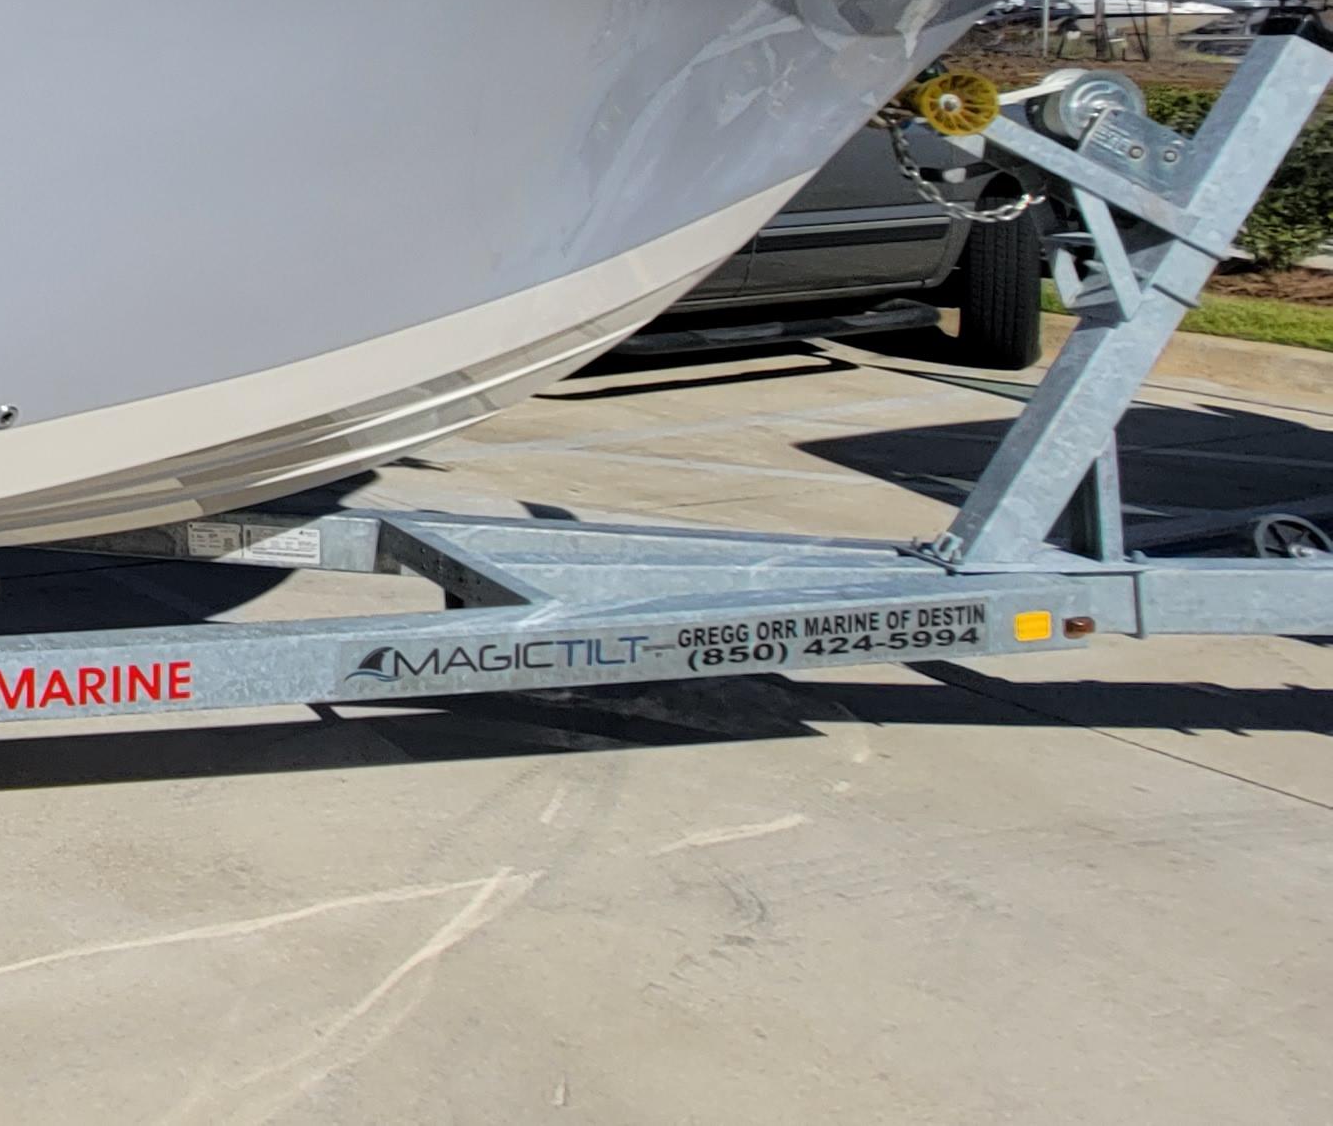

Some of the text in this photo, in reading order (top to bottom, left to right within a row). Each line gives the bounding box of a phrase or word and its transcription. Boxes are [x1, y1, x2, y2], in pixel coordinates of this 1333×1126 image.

[678, 603, 986, 648] GREGG ORR MARINE OF DESTIN
[687, 626, 980, 671] (850) 424-5994
